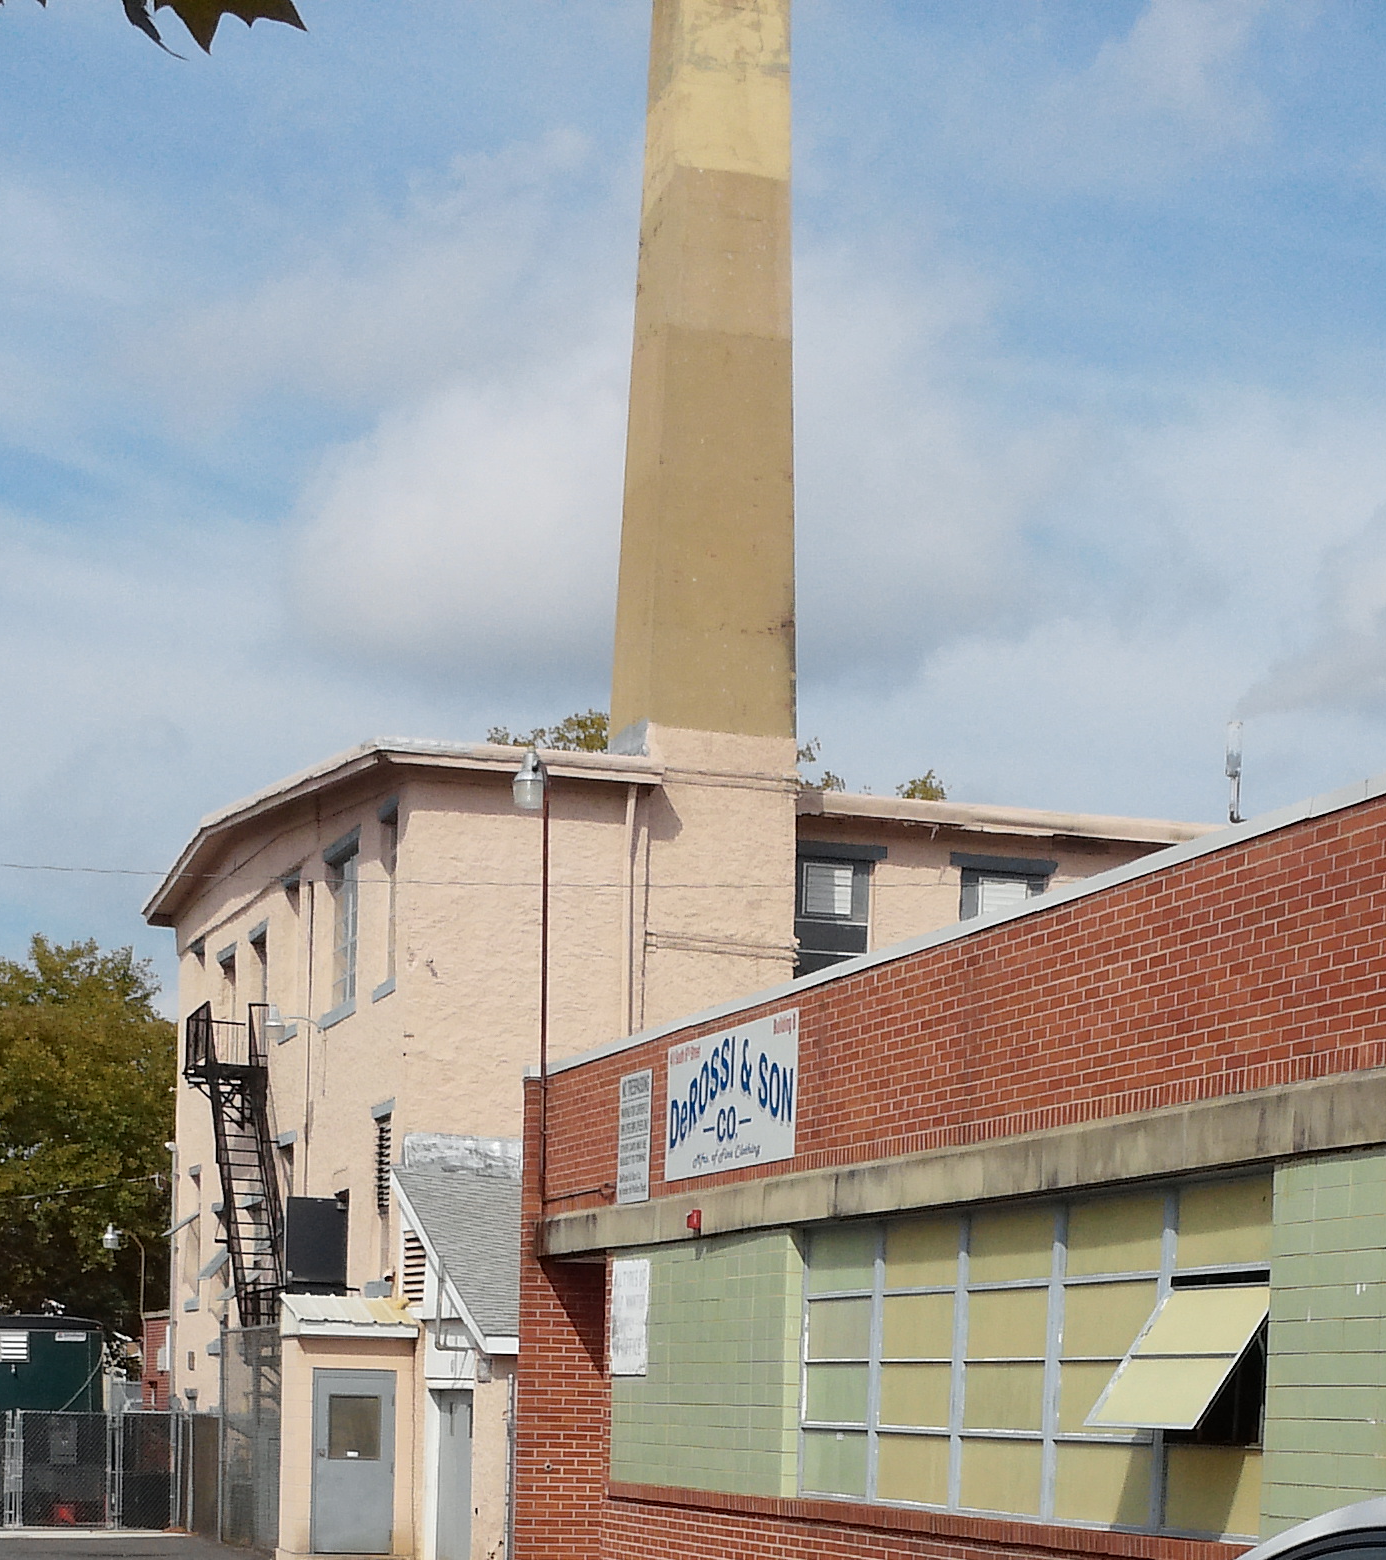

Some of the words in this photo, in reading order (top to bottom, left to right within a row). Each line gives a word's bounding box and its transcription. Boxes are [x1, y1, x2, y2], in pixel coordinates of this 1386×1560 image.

[669, 1036, 735, 1149] DeROSSI
[741, 1038, 752, 1094] &
[758, 1052, 794, 1122] SON
